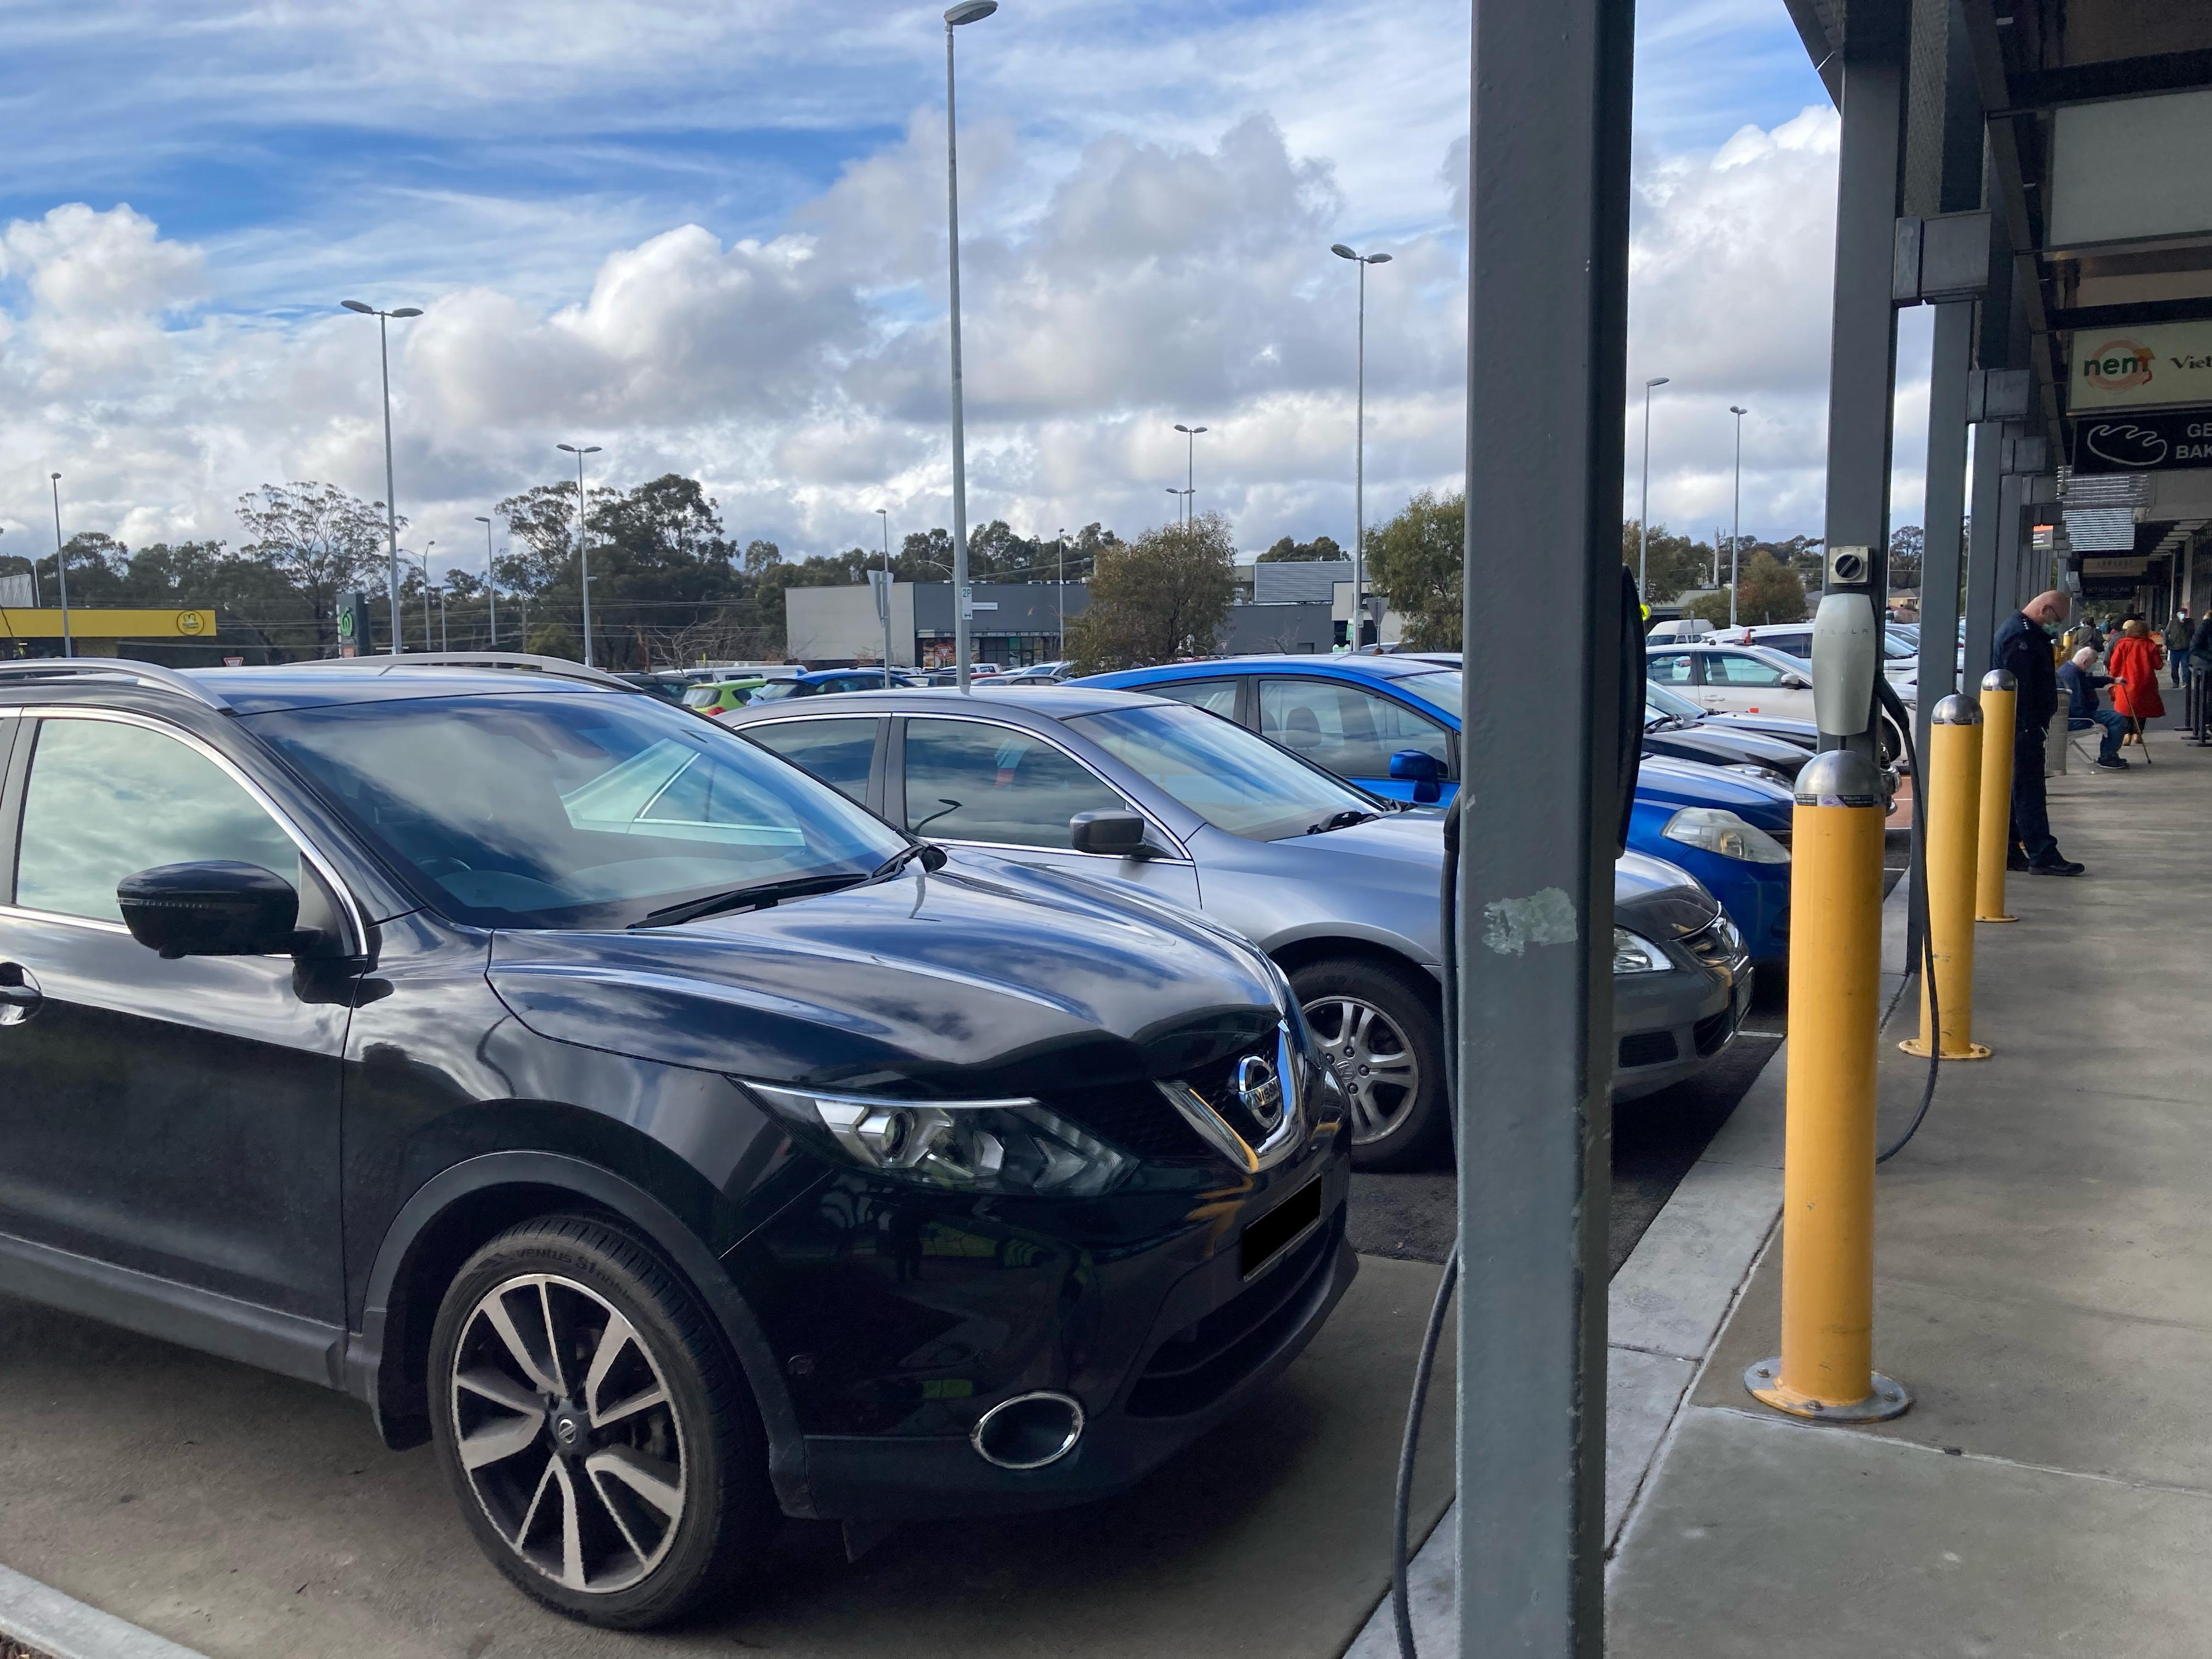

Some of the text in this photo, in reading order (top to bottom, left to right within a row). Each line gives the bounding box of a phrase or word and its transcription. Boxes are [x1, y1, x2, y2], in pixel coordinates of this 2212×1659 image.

[2084, 357, 2148, 376] nem
[2187, 423, 2212, 437] GE
[963, 589, 970, 597] 2P
